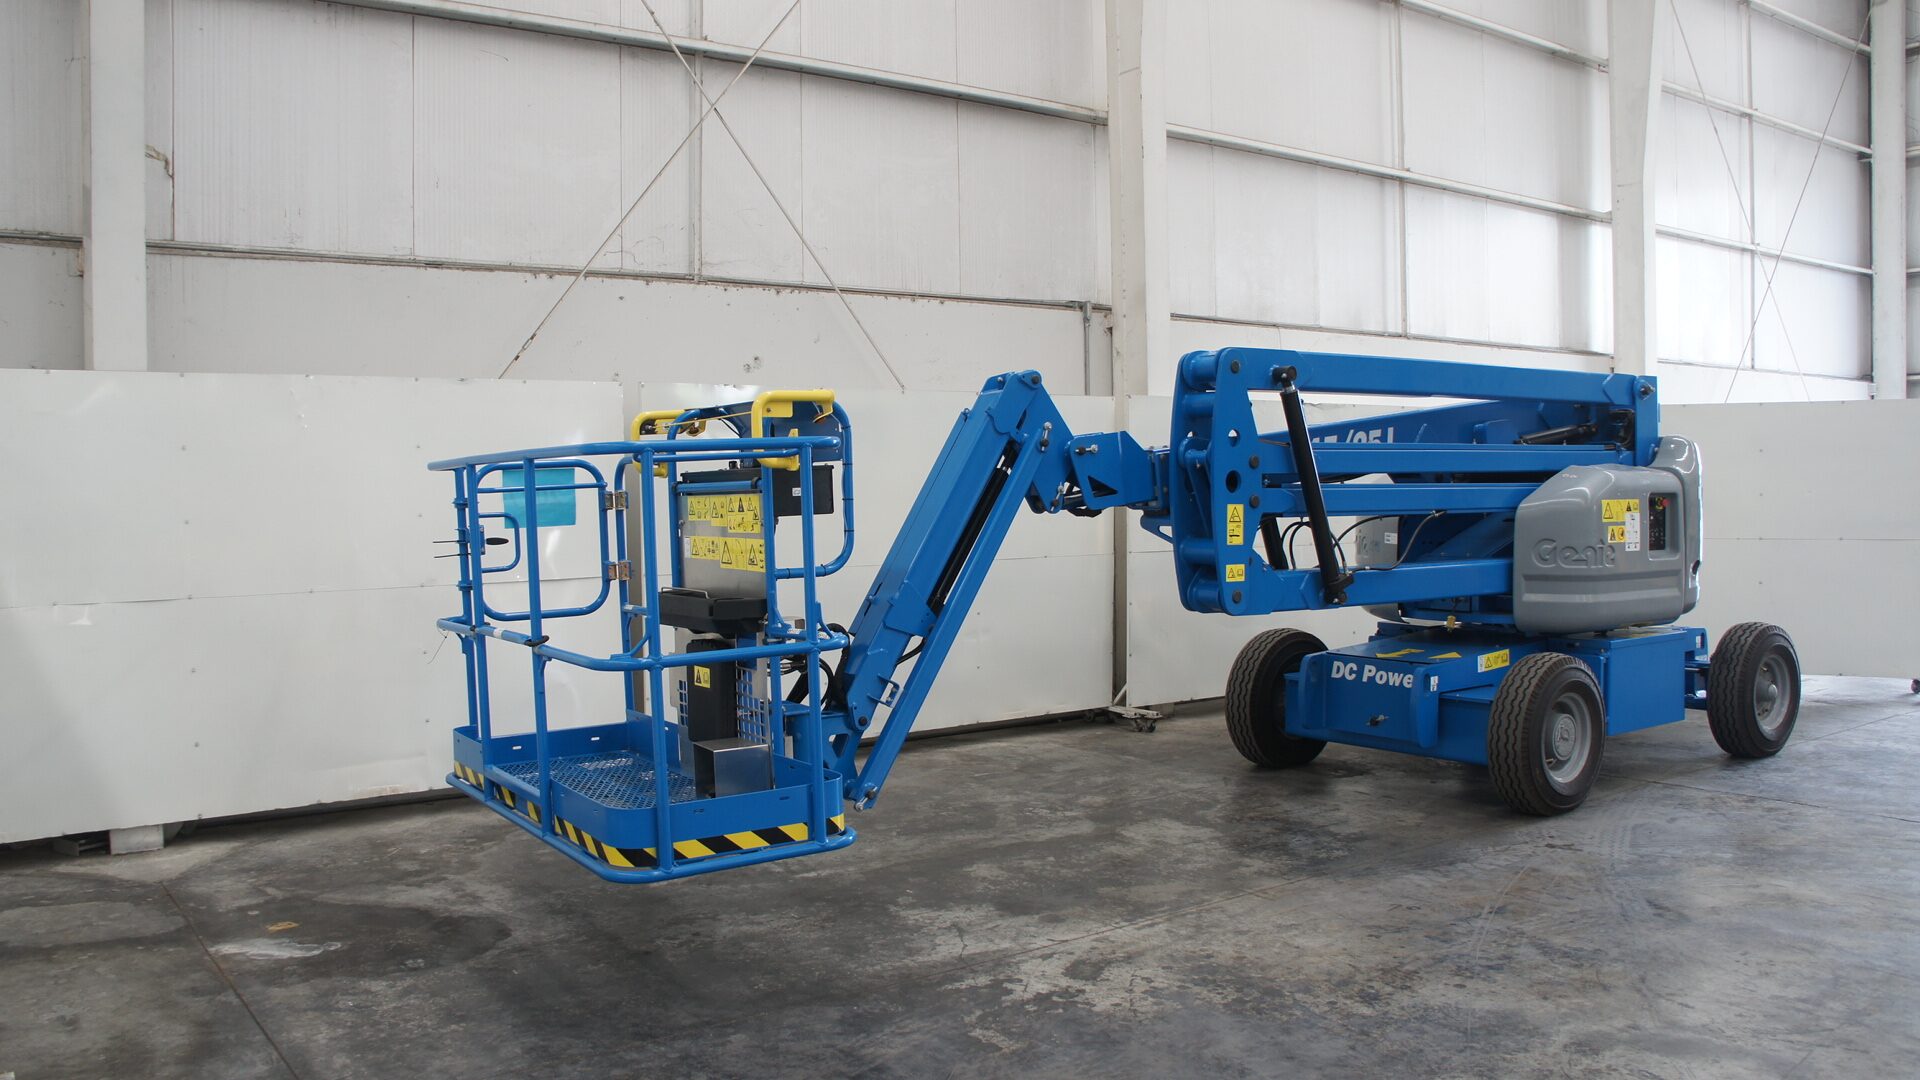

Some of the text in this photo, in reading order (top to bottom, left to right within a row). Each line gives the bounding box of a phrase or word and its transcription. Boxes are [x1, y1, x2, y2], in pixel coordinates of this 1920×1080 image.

[1531, 538, 1616, 568] Genie
[1331, 660, 1358, 681] DC
[1362, 664, 1415, 689] Powe
